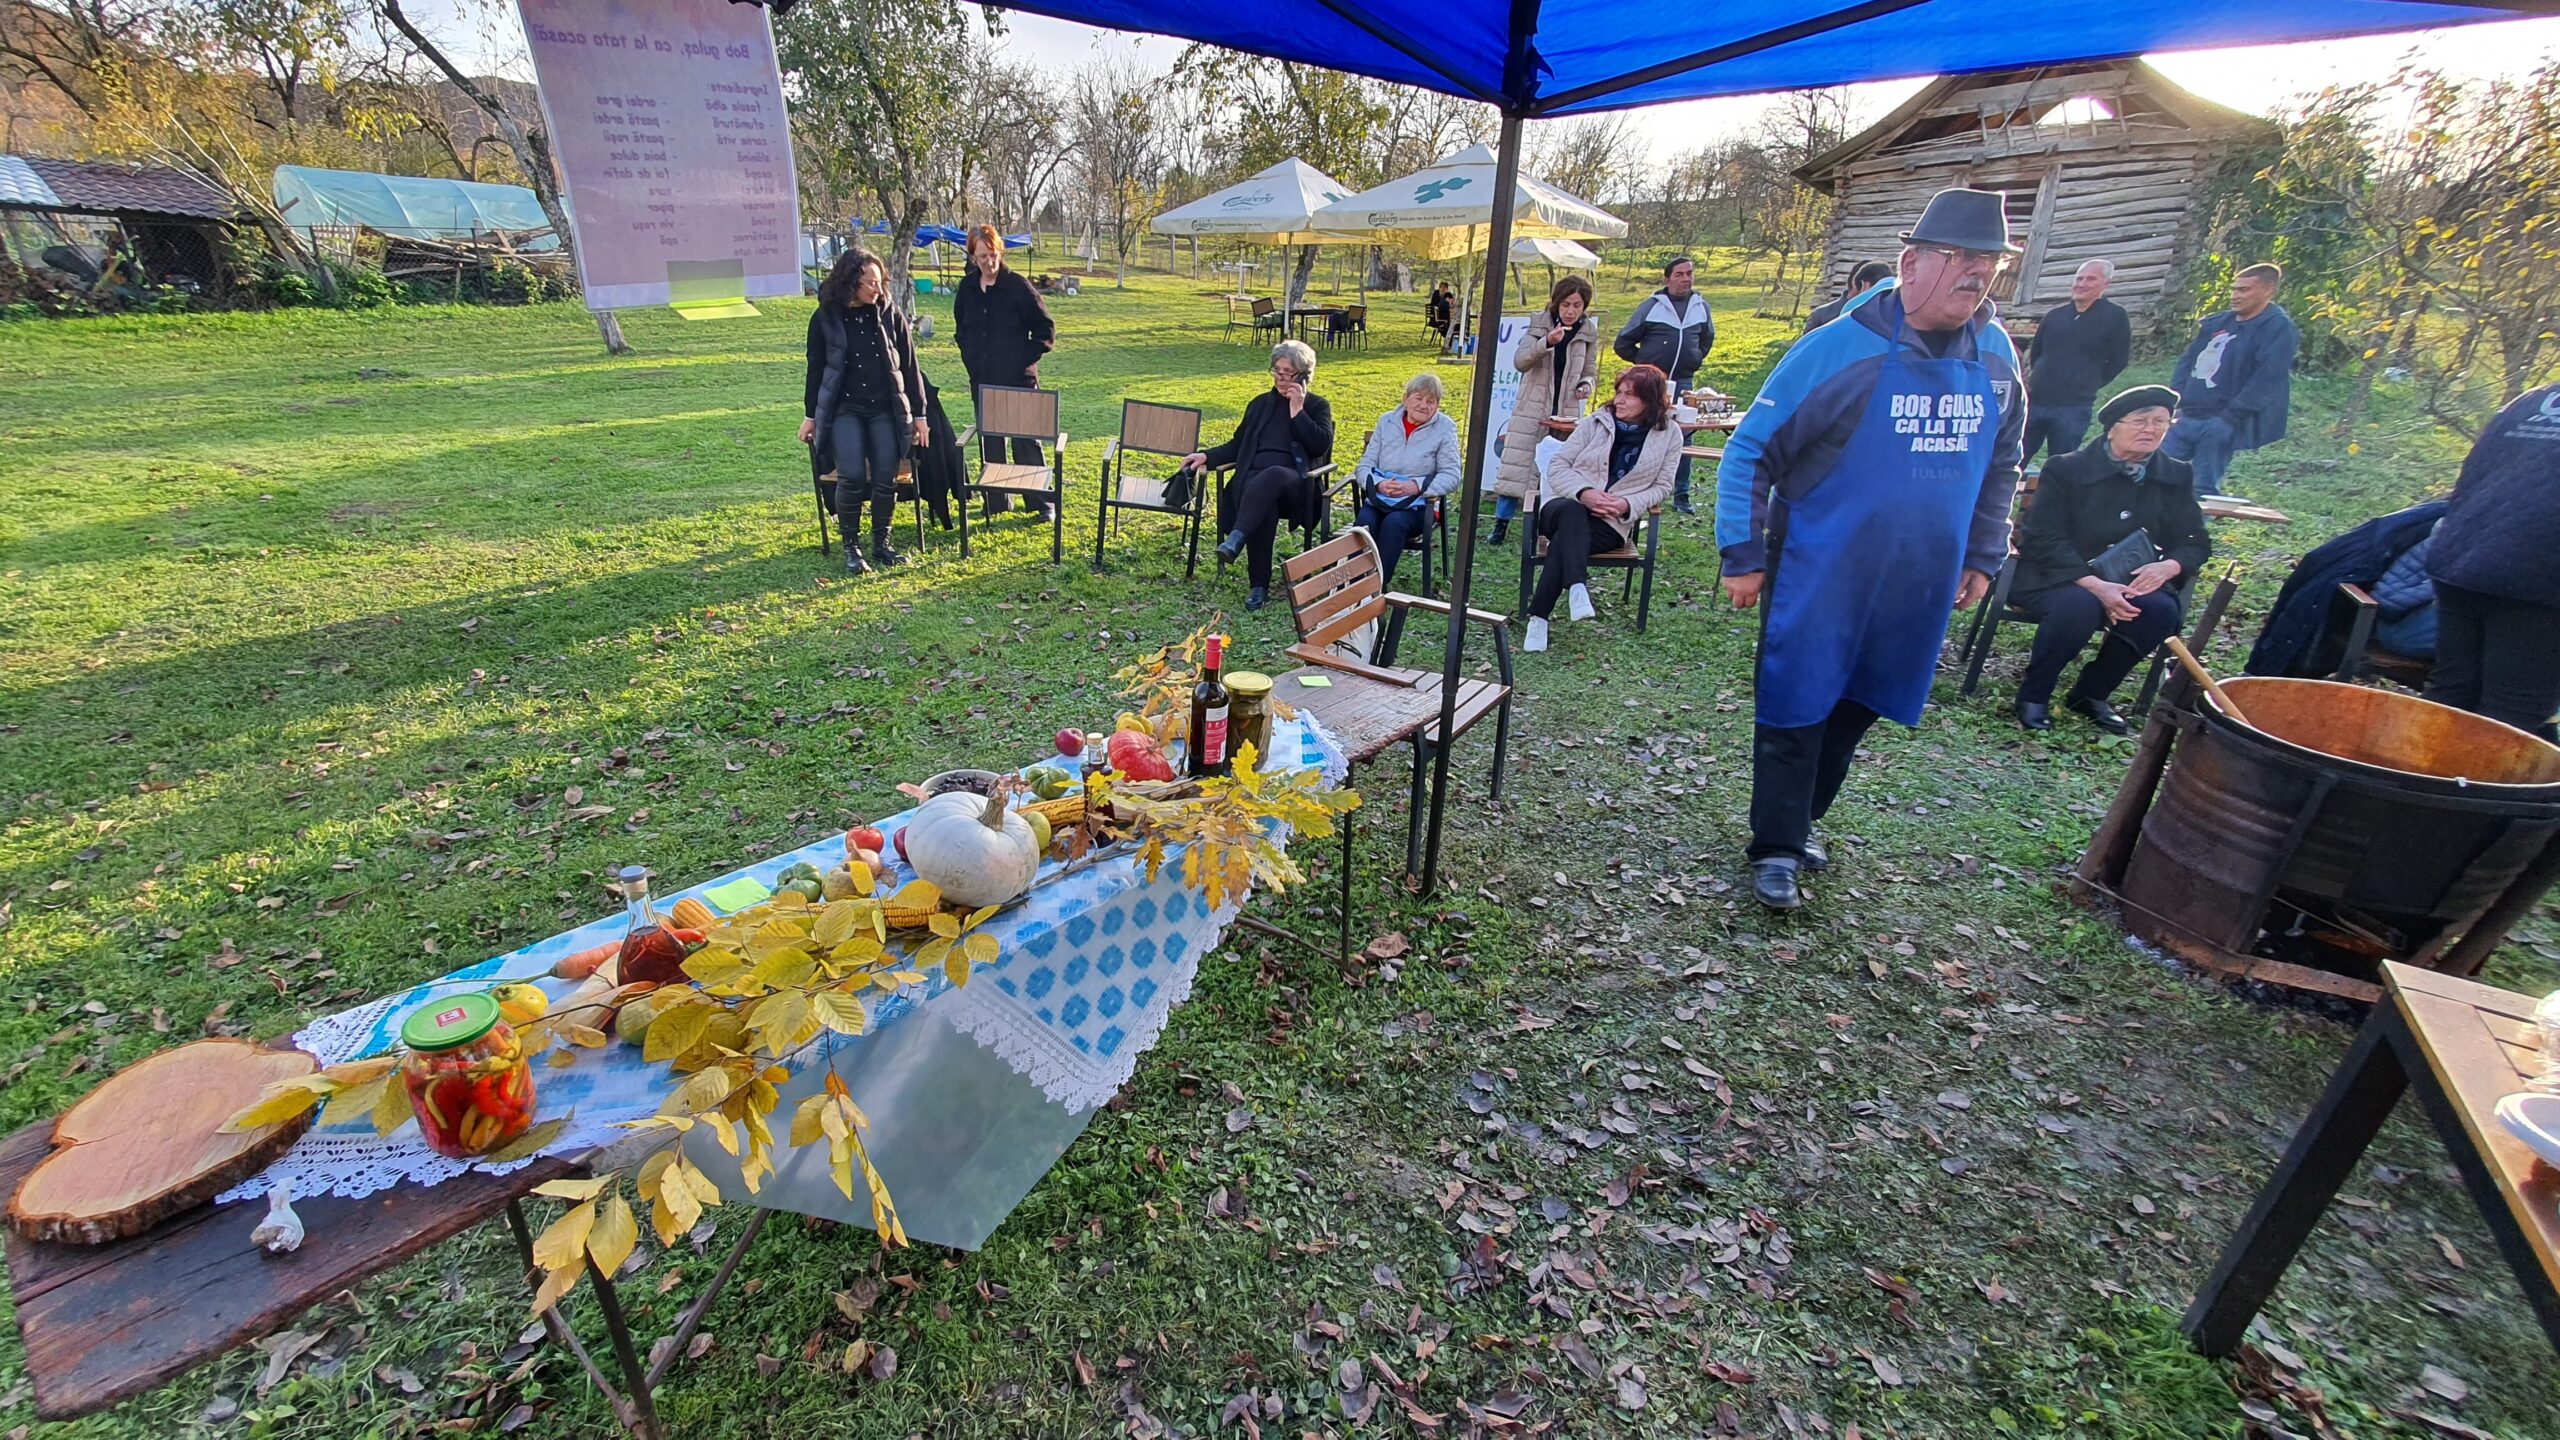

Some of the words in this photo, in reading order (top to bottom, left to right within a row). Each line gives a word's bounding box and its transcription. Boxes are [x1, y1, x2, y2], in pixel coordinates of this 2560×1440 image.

[1890, 394, 1932, 418] BOB
[1895, 418, 1919, 434] CA
[1924, 419, 1945, 434] LA
